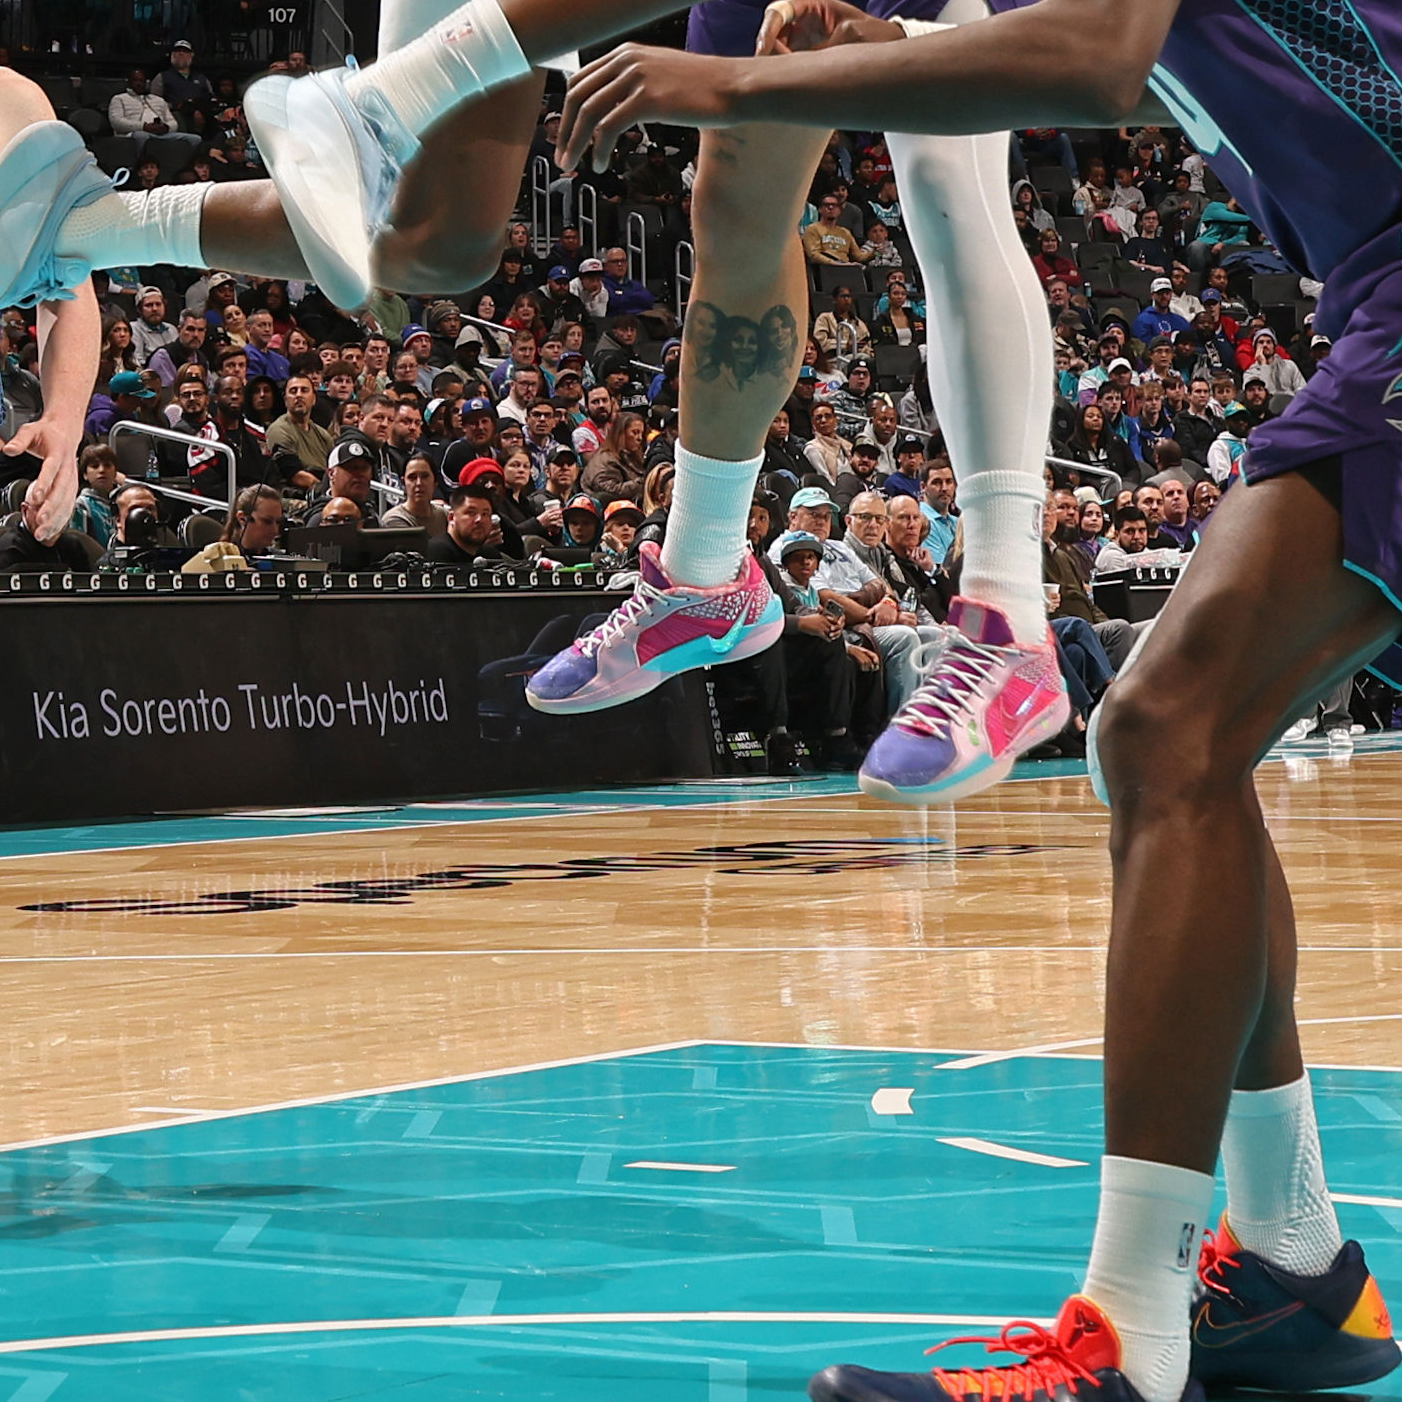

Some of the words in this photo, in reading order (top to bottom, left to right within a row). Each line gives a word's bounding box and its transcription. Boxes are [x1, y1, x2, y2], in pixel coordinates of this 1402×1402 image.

[267, 7, 297, 24] 107
[32, 690, 90, 740] Kia
[99, 688, 232, 737] Sorento
[238, 678, 449, 737] Turbo-Hybrid
